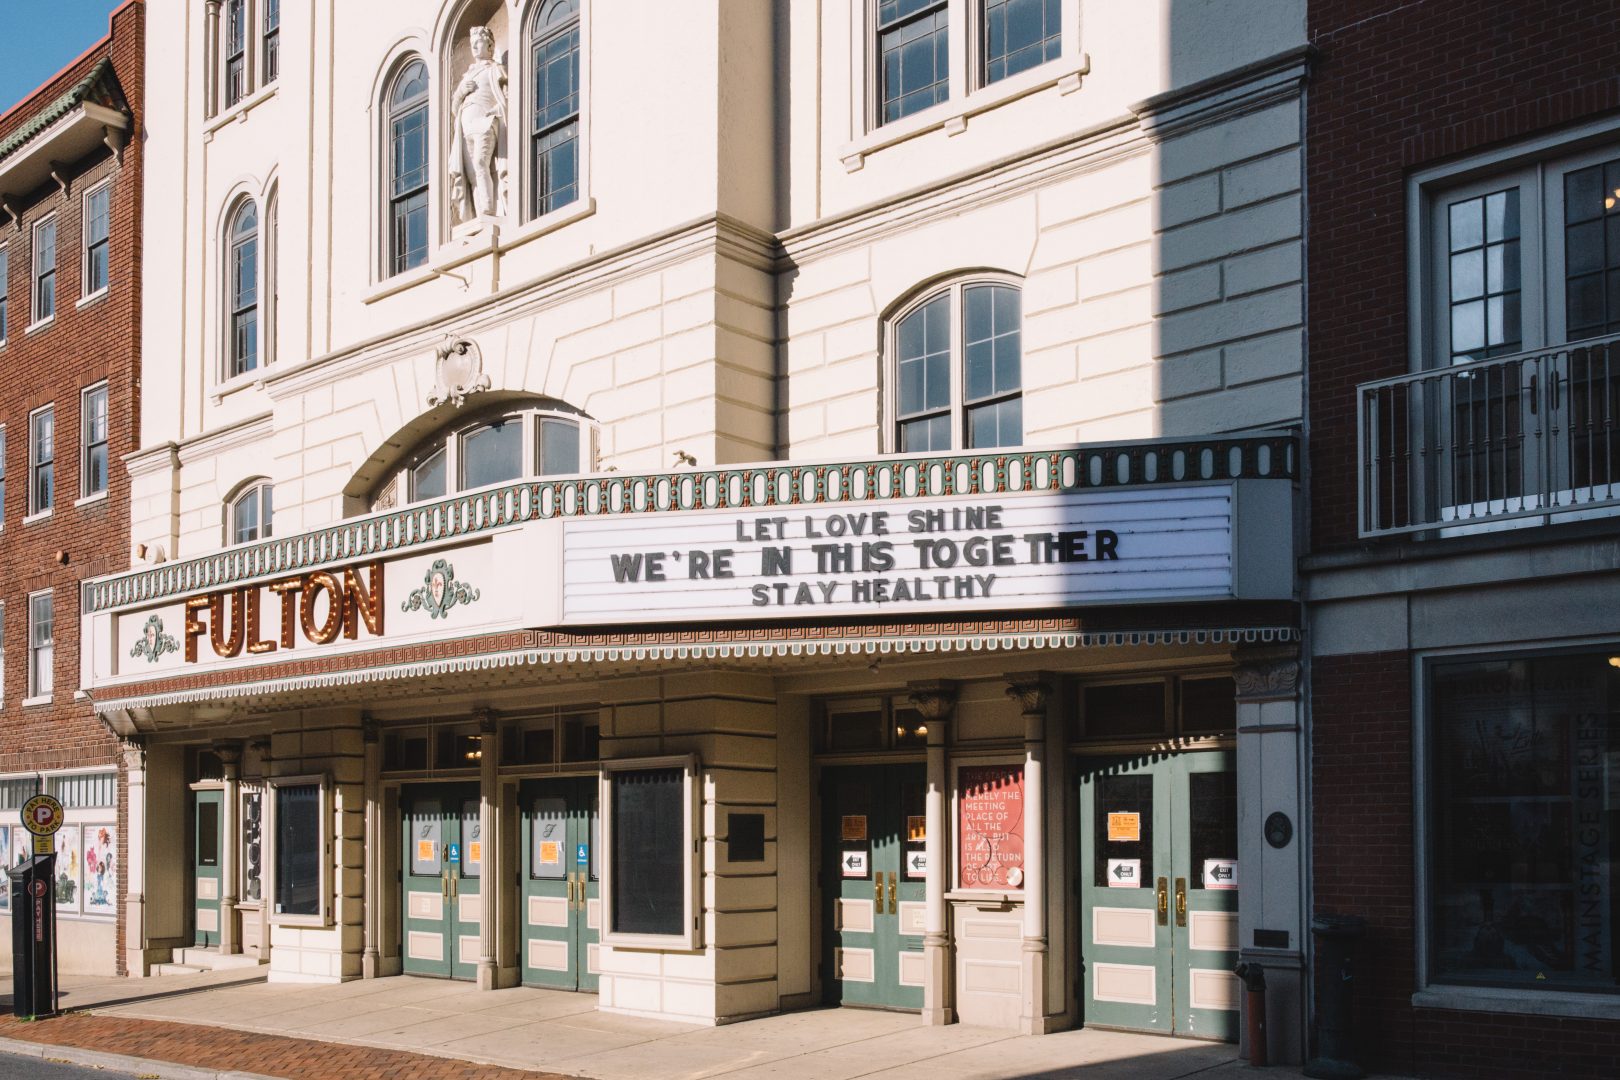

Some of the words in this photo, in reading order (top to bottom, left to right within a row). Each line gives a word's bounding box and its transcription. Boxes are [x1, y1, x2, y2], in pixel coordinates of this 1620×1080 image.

[736, 517, 787, 542] LET
[805, 511, 889, 538] LOVE
[908, 505, 1002, 533] SHINE
[611, 548, 734, 583] WE'RE
[761, 545, 792, 576] IN
[811, 541, 894, 574] THIS
[913, 529, 1119, 569] TOGETHER
[751, 580, 837, 607] STAY
[851, 573, 996, 603] HEALTHY
[185, 560, 384, 663] FULTON
[1577, 712, 1600, 799] SERIES
[965, 792, 1001, 801] MERELY
[1002, 791, 1020, 800] THE
[26, 799, 40, 813] PAY
[41, 797, 60, 812] HERE
[965, 802, 1006, 811] MEETING
[37, 807, 52, 824] P
[965, 812, 994, 821] PLACE
[996, 812, 1009, 820] OF
[27, 820, 37, 830] TO
[40, 820, 60, 833] PARK
[965, 822, 982, 831] ALL
[983, 822, 1002, 831] THE
[992, 832, 1010, 841] BUT
[965, 843, 973, 851] IS
[965, 853, 982, 862] THE
[984, 853, 1021, 862] RETURN
[1579, 806, 1603, 972] MAINSTAGE
